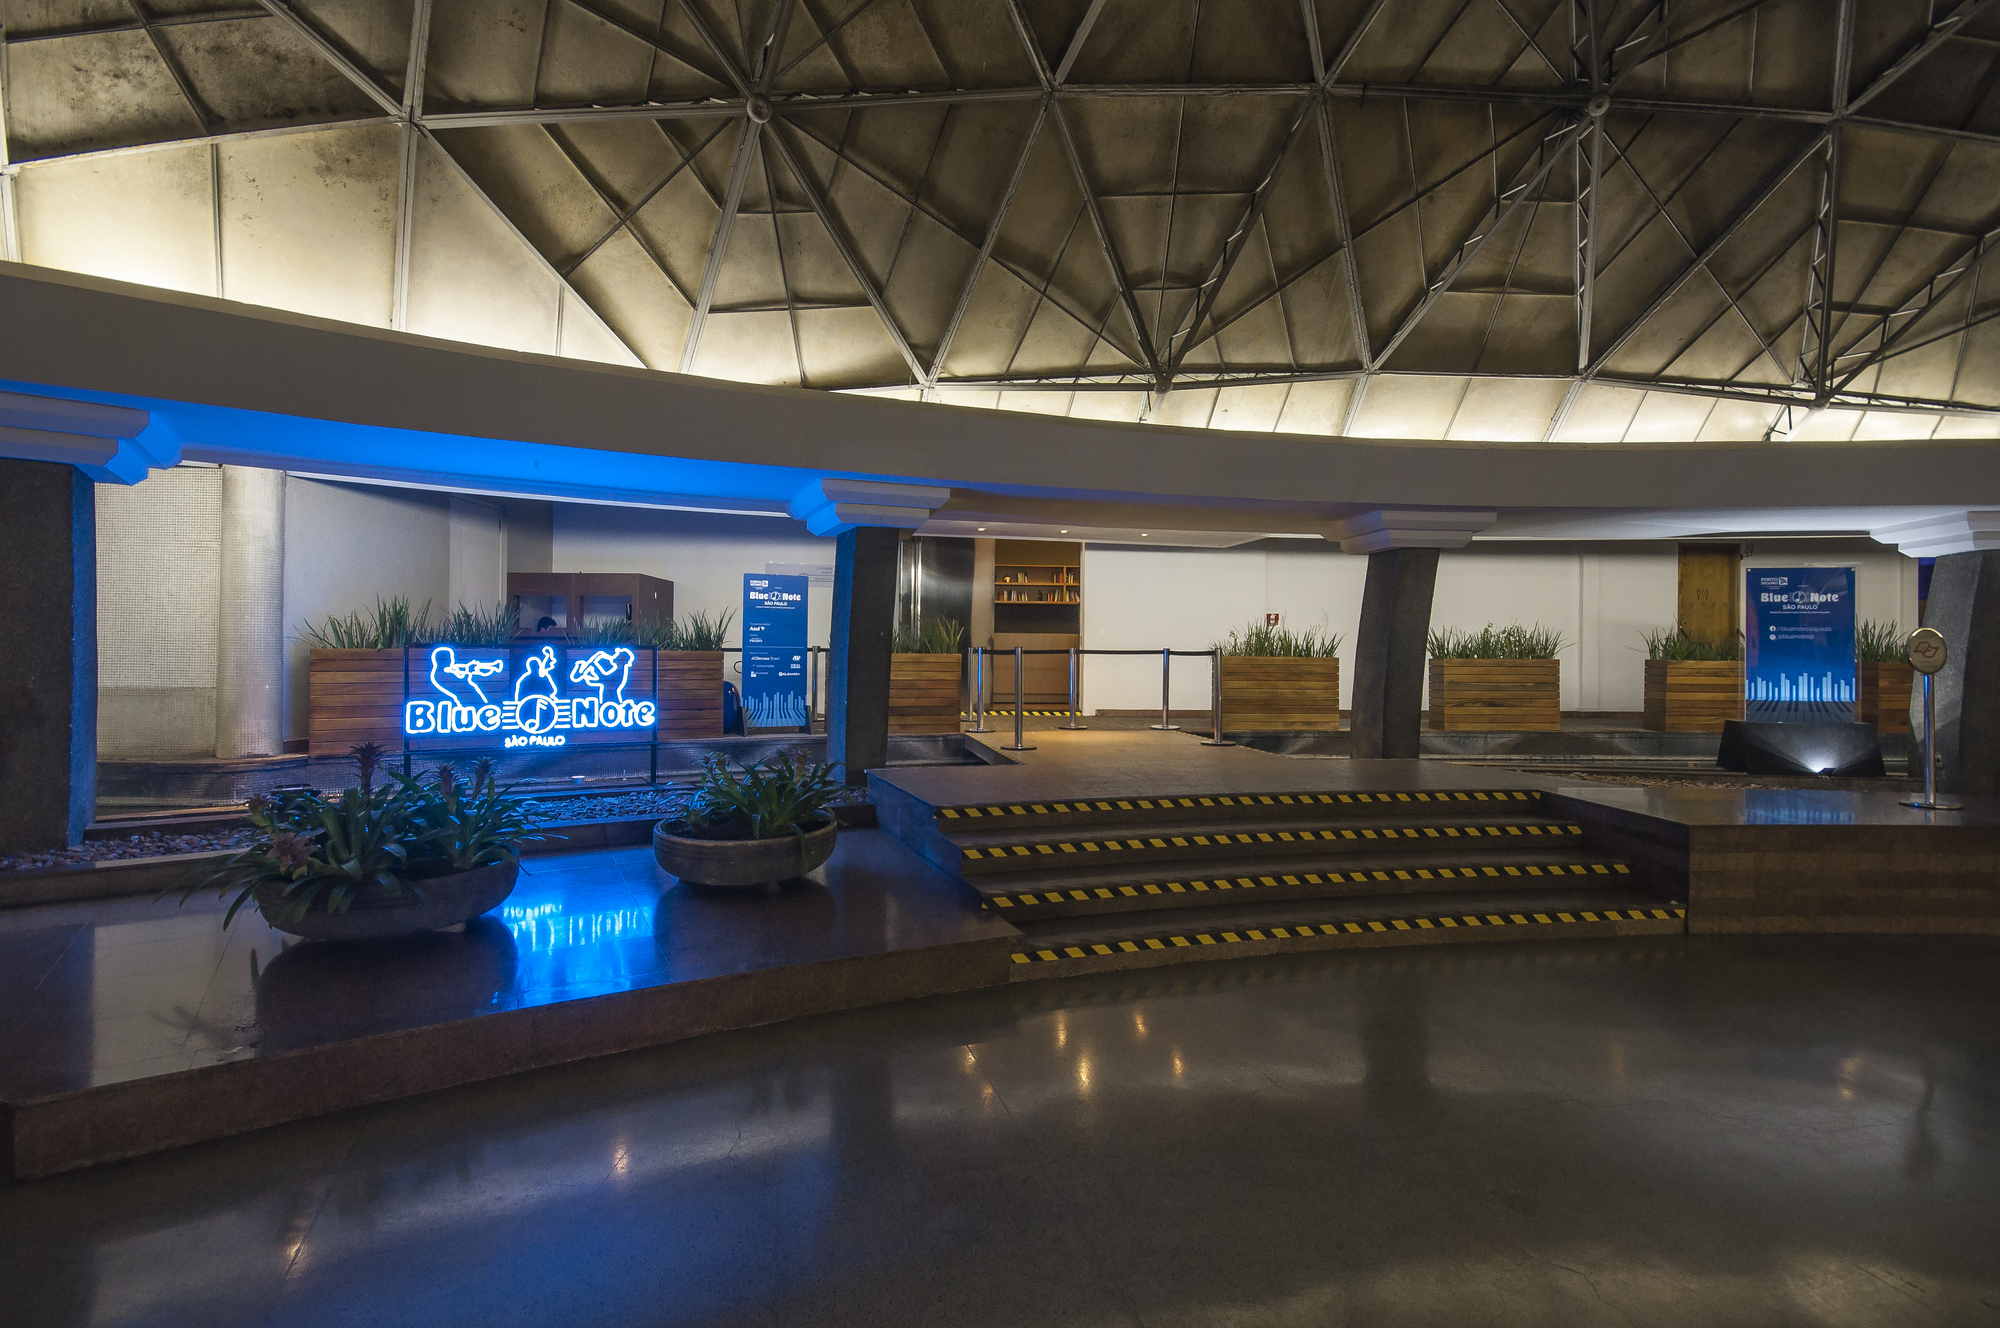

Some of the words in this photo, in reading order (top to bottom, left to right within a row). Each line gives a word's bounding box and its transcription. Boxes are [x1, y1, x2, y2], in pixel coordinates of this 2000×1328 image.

[749, 591, 769, 600] Blue
[782, 592, 802, 601] Note
[1760, 592, 1789, 603] Blue
[1809, 592, 1839, 603] Note
[405, 700, 501, 734] Blue
[572, 697, 656, 728] Note
[504, 734, 528, 748] SÃO
[529, 734, 566, 747] PAULO
